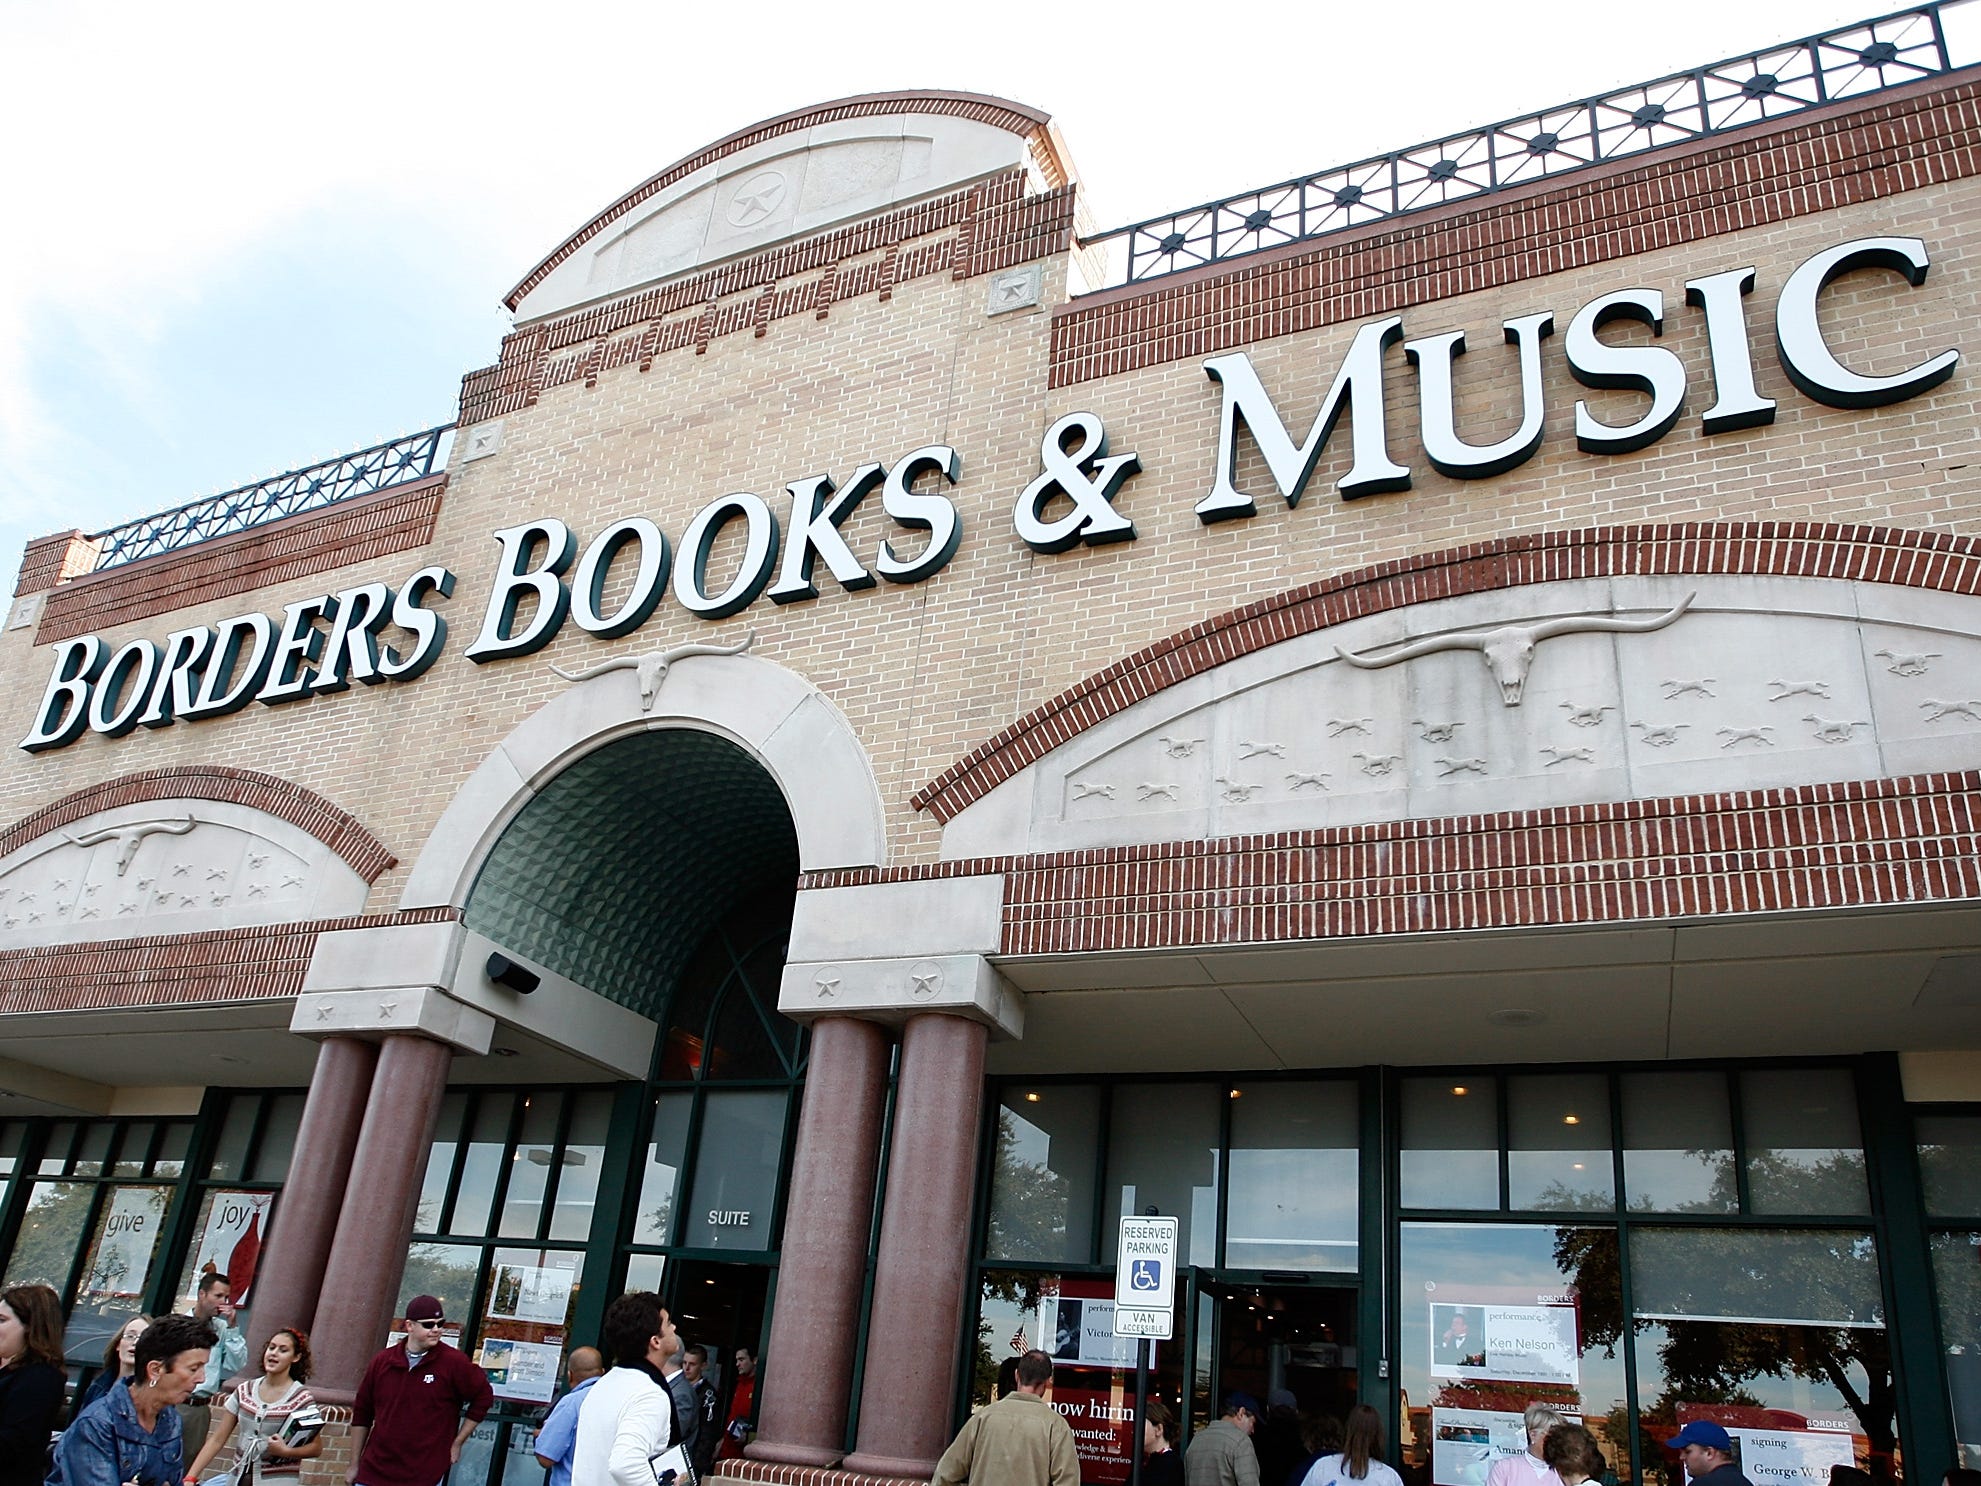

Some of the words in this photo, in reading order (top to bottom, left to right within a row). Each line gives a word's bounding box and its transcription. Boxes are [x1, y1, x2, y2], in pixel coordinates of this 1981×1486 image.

[19, 566, 456, 753] BORDERS
[464, 445, 960, 664] BOOKS
[1014, 411, 1142, 554] &
[1194, 236, 1960, 525] MUSIC
[216, 1200, 250, 1231] joy
[707, 1209, 751, 1226] SUITE
[106, 1209, 144, 1238] give
[1124, 1226, 1173, 1239] RESERVED
[1126, 1241, 1169, 1255] PARKING
[1537, 1294, 1575, 1303] BORDERS
[1088, 1304, 1115, 1314] perform
[1132, 1312, 1155, 1324] VAN
[1489, 1311, 1542, 1322] performance
[1086, 1328, 1114, 1339] Victor
[1122, 1323, 1164, 1334] ACCESSIBLE
[1489, 1337, 1513, 1349] Ken
[1515, 1339, 1556, 1351] Nelson
[1089, 1398, 1135, 1422] hirin
[1549, 1402, 1581, 1412] ORDERS
[1806, 1419, 1849, 1429] BORDERS
[1071, 1427, 1117, 1441] wanted:
[1075, 1442, 1100, 1454] wledge
[1100, 1445, 1106, 1453] &
[1751, 1437, 1787, 1449] signing
[1495, 1444, 1527, 1455] Aman
[1753, 1463, 1798, 1480] George
[1801, 1467, 1817, 1478] W.
